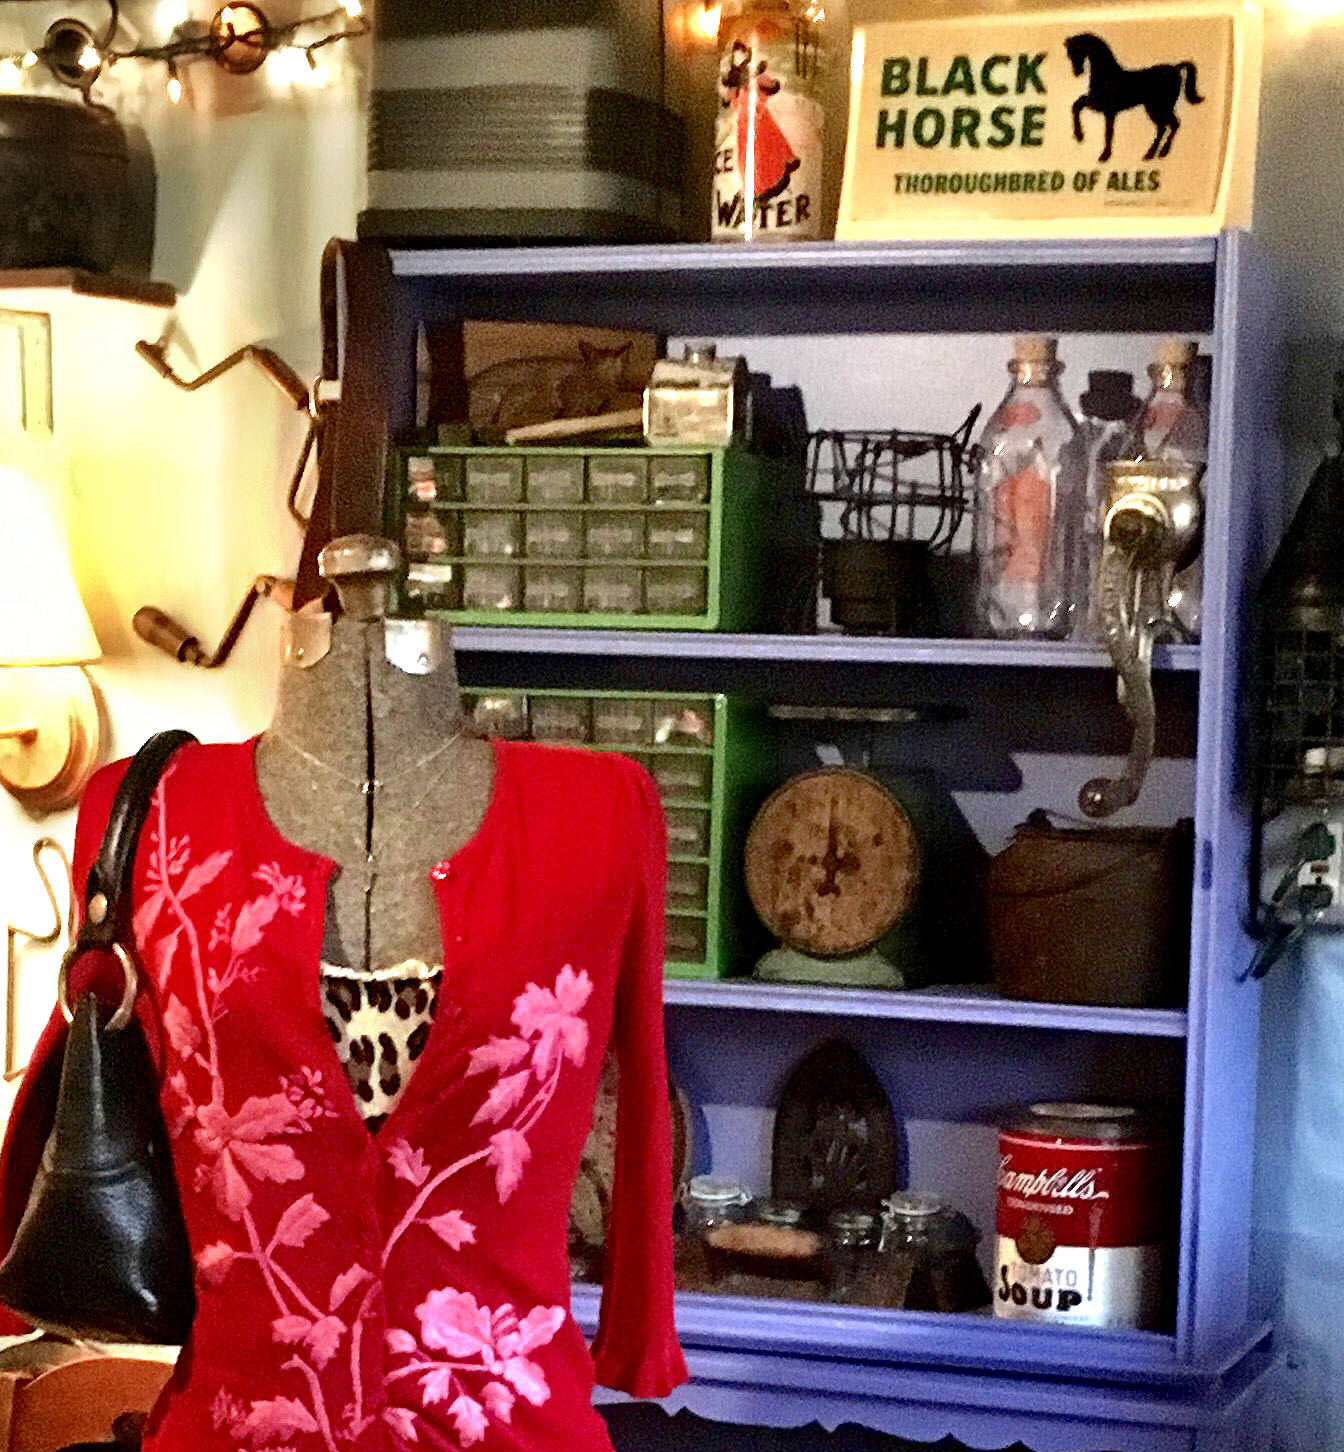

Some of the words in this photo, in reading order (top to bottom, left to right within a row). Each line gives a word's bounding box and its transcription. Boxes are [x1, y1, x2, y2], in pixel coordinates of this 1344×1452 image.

[880, 51, 1049, 96] BLACK
[875, 104, 1048, 150] HORSE
[894, 170, 1065, 193] THOROUGHBRED
[1072, 170, 1102, 192] OF
[1106, 170, 1161, 192] ALES
[998, 1264, 1083, 1312] SOUP
